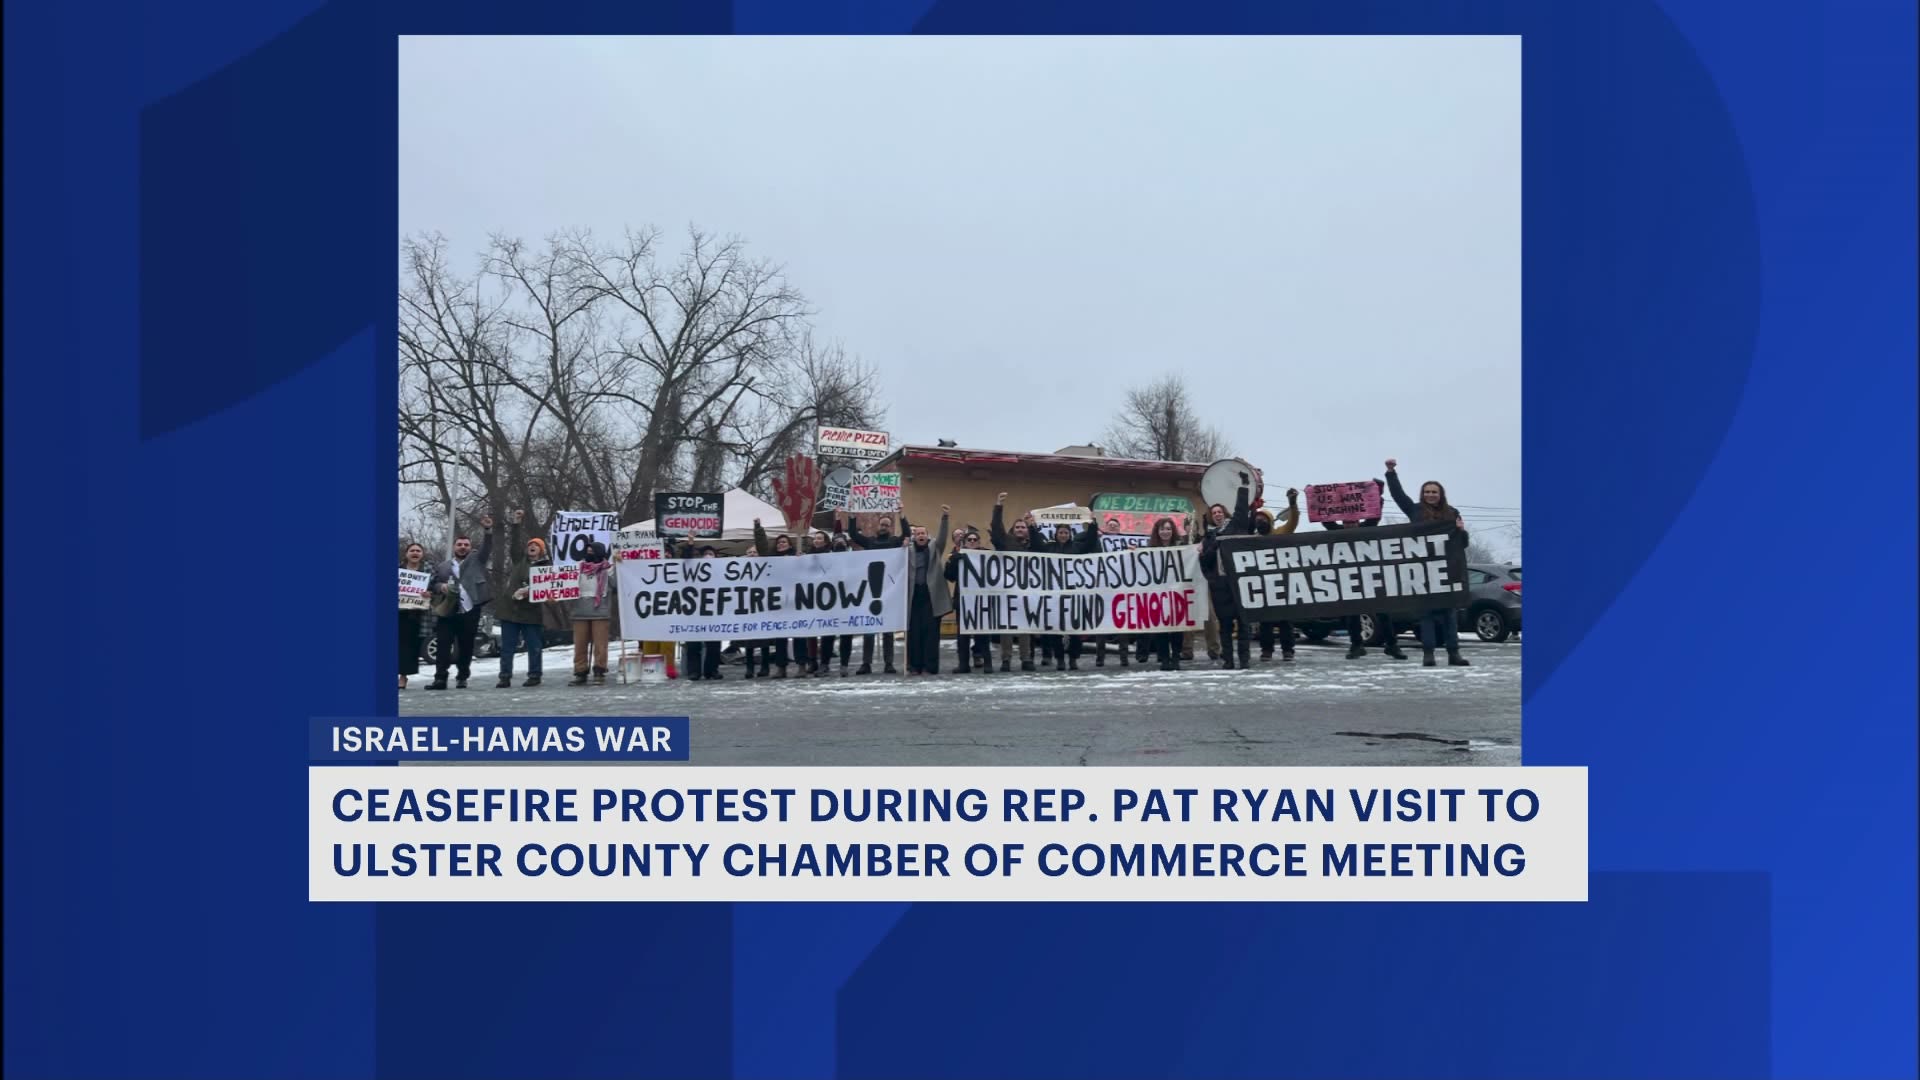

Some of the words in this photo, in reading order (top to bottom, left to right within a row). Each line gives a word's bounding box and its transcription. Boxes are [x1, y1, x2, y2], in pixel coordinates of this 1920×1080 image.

[854, 432, 886, 445] PIZZA
[853, 474, 870, 485] NO
[668, 496, 704, 509] STOP
[702, 502, 718, 511] THE
[825, 499, 846, 507] NOW
[1099, 497, 1119, 509] WE
[1123, 497, 1187, 511] DELIVER
[1341, 493, 1364, 502] WAR
[665, 517, 720, 530] GENOCIDE
[616, 531, 630, 540] PAT
[619, 549, 661, 560] ENOCIDE
[1232, 534, 1449, 573] PERMANENT
[641, 562, 711, 584] JEWS
[724, 561, 772, 581] SAY:
[551, 581, 563, 589] IN
[634, 586, 782, 619] CEASEFIRE
[794, 561, 886, 616] NOW!
[1238, 560, 1463, 609] CEASEFIRE.
[533, 587, 580, 601] NOVEMBER
[961, 594, 1018, 631] WHILE
[1023, 595, 1053, 631] WE
[1059, 593, 1105, 632] FUND
[1111, 589, 1196, 630] GENOCIDE
[669, 624, 707, 634] JEWISH
[709, 623, 740, 633] VOICE
[742, 622, 758, 632] FOR
